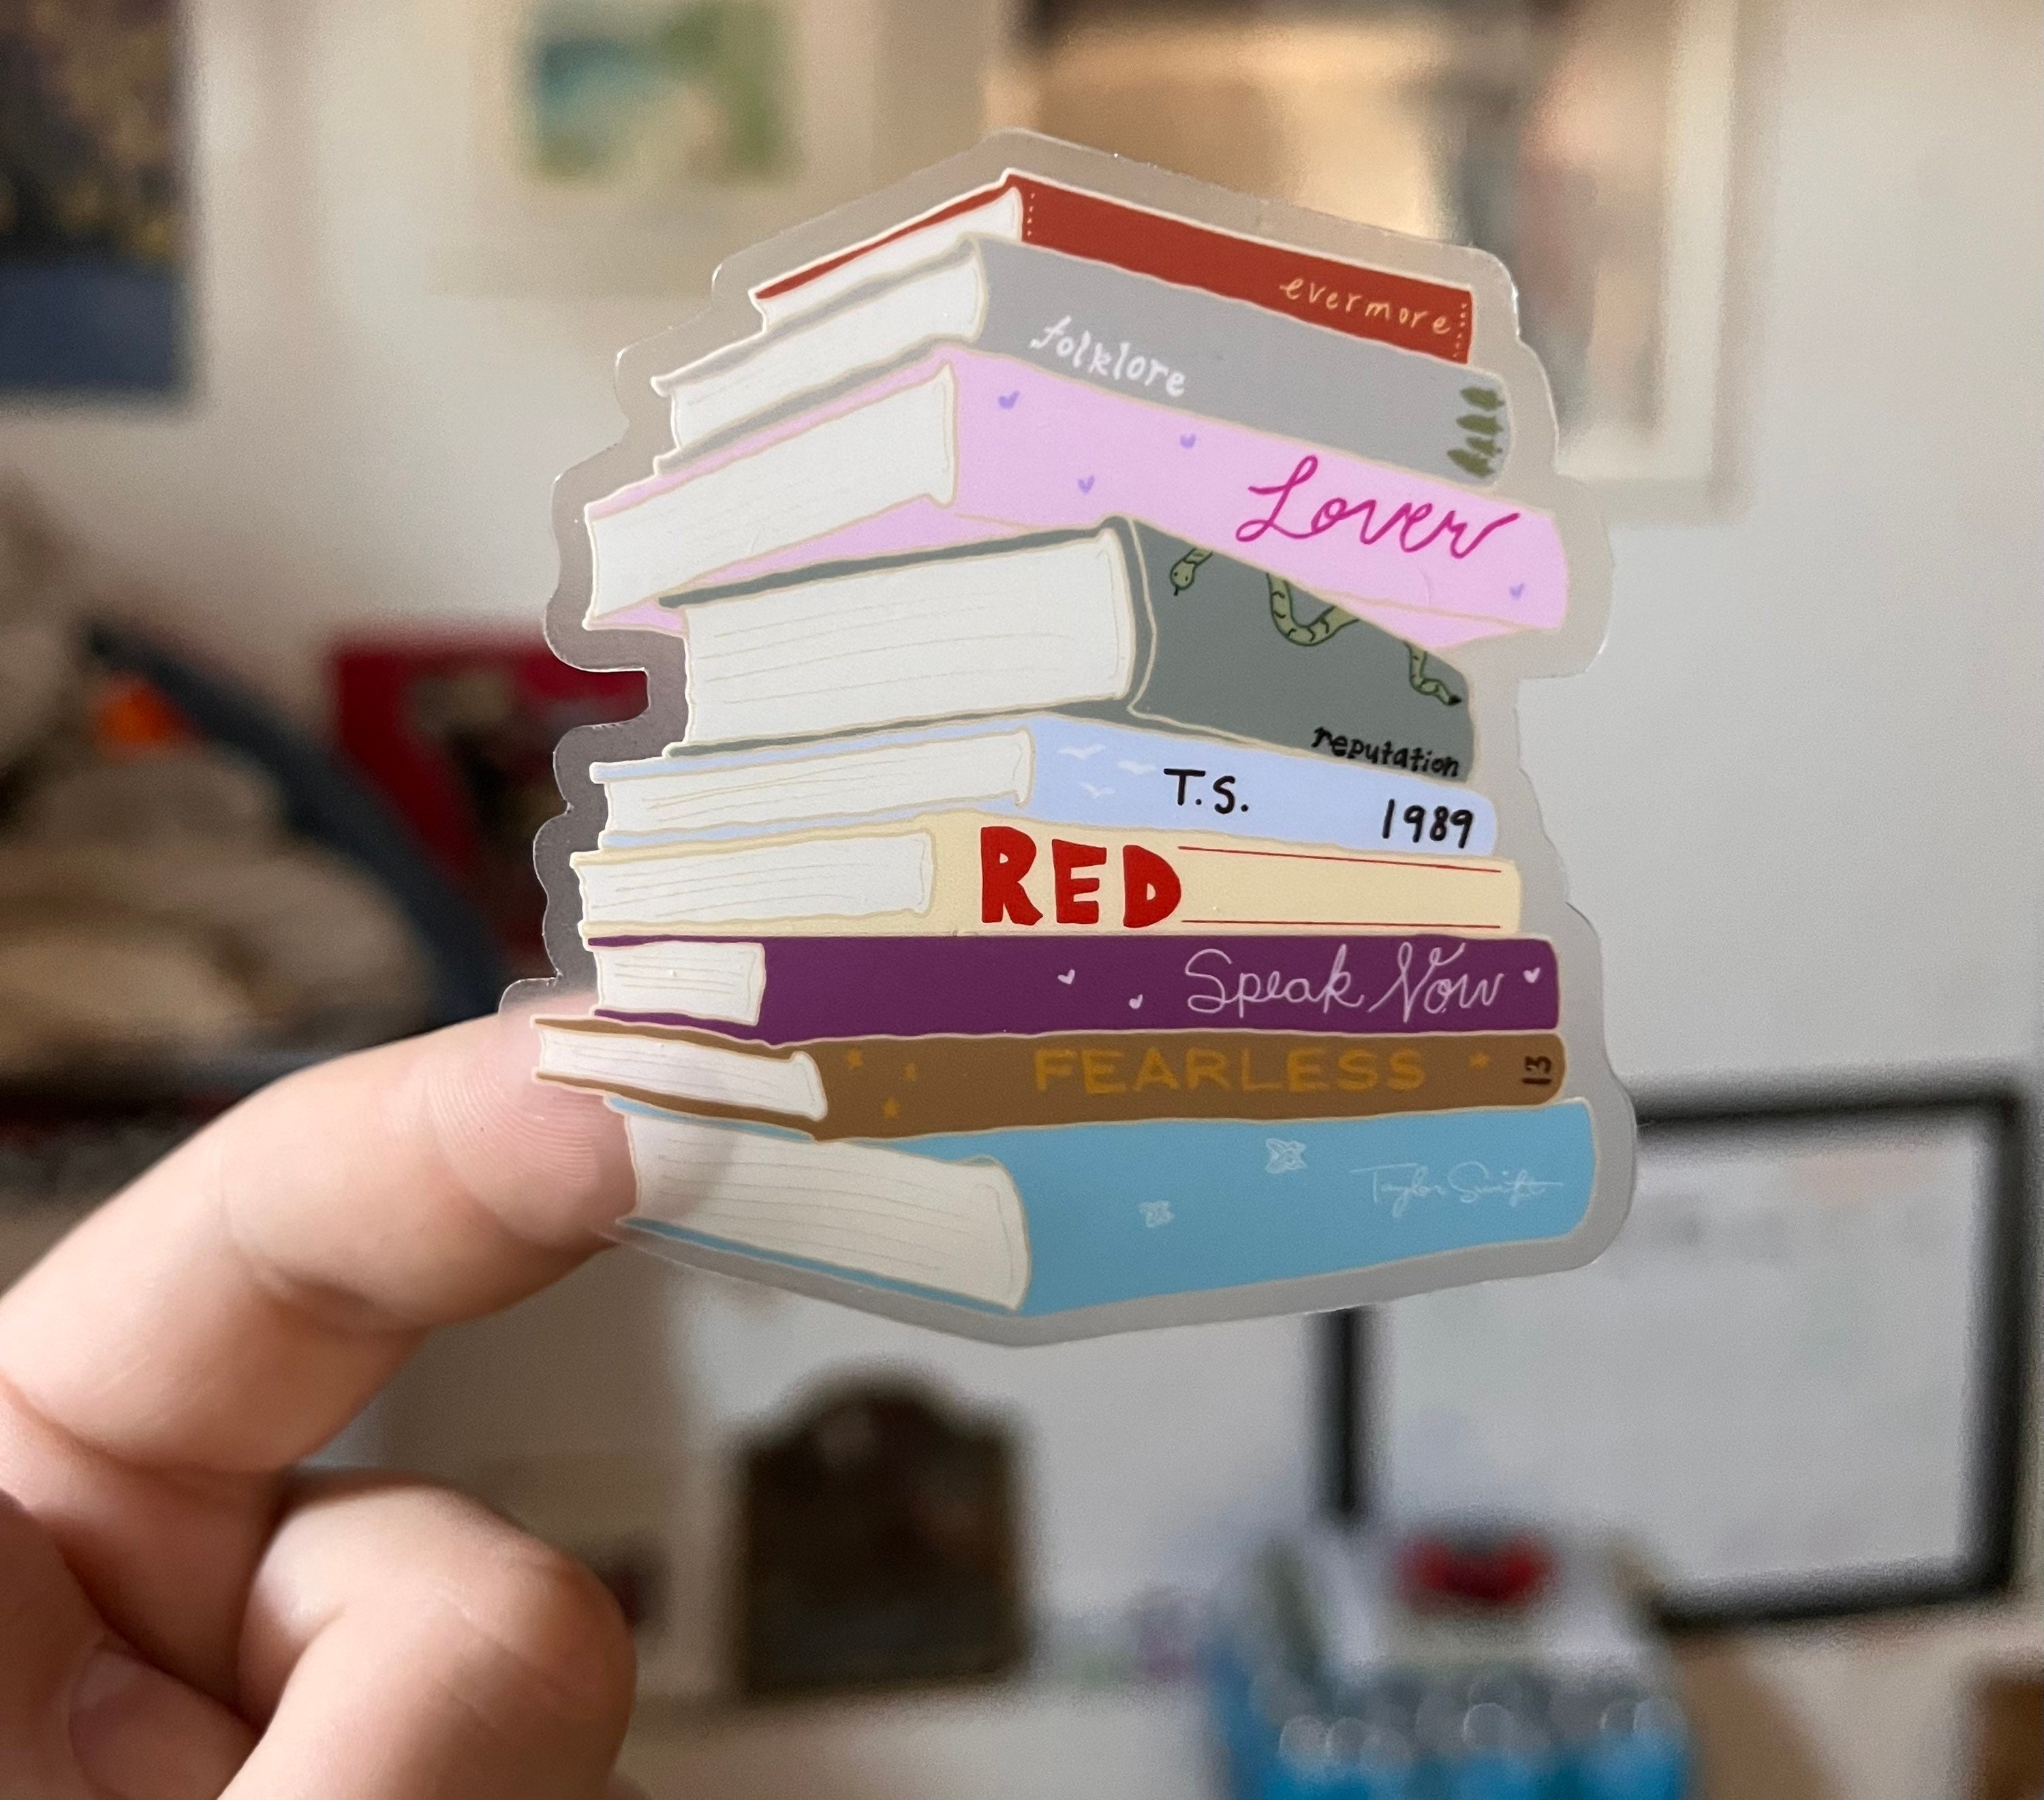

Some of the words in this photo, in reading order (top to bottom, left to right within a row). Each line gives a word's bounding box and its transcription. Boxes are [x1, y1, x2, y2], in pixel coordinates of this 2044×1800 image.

[1280, 276, 1451, 335] evermore
[1029, 315, 1186, 397] folklore
[1236, 455, 1520, 558] Lover
[1312, 726, 1460, 778] reputation
[1164, 768, 1250, 813] T.S.
[1382, 799, 1474, 848] 1989
[980, 826, 1181, 928] RED
[1185, 944, 1364, 1018] Speak
[1367, 941, 1504, 1023] Now
[1034, 1046, 1426, 1093] FEARLESS
[1521, 1055, 1552, 1085] 13
